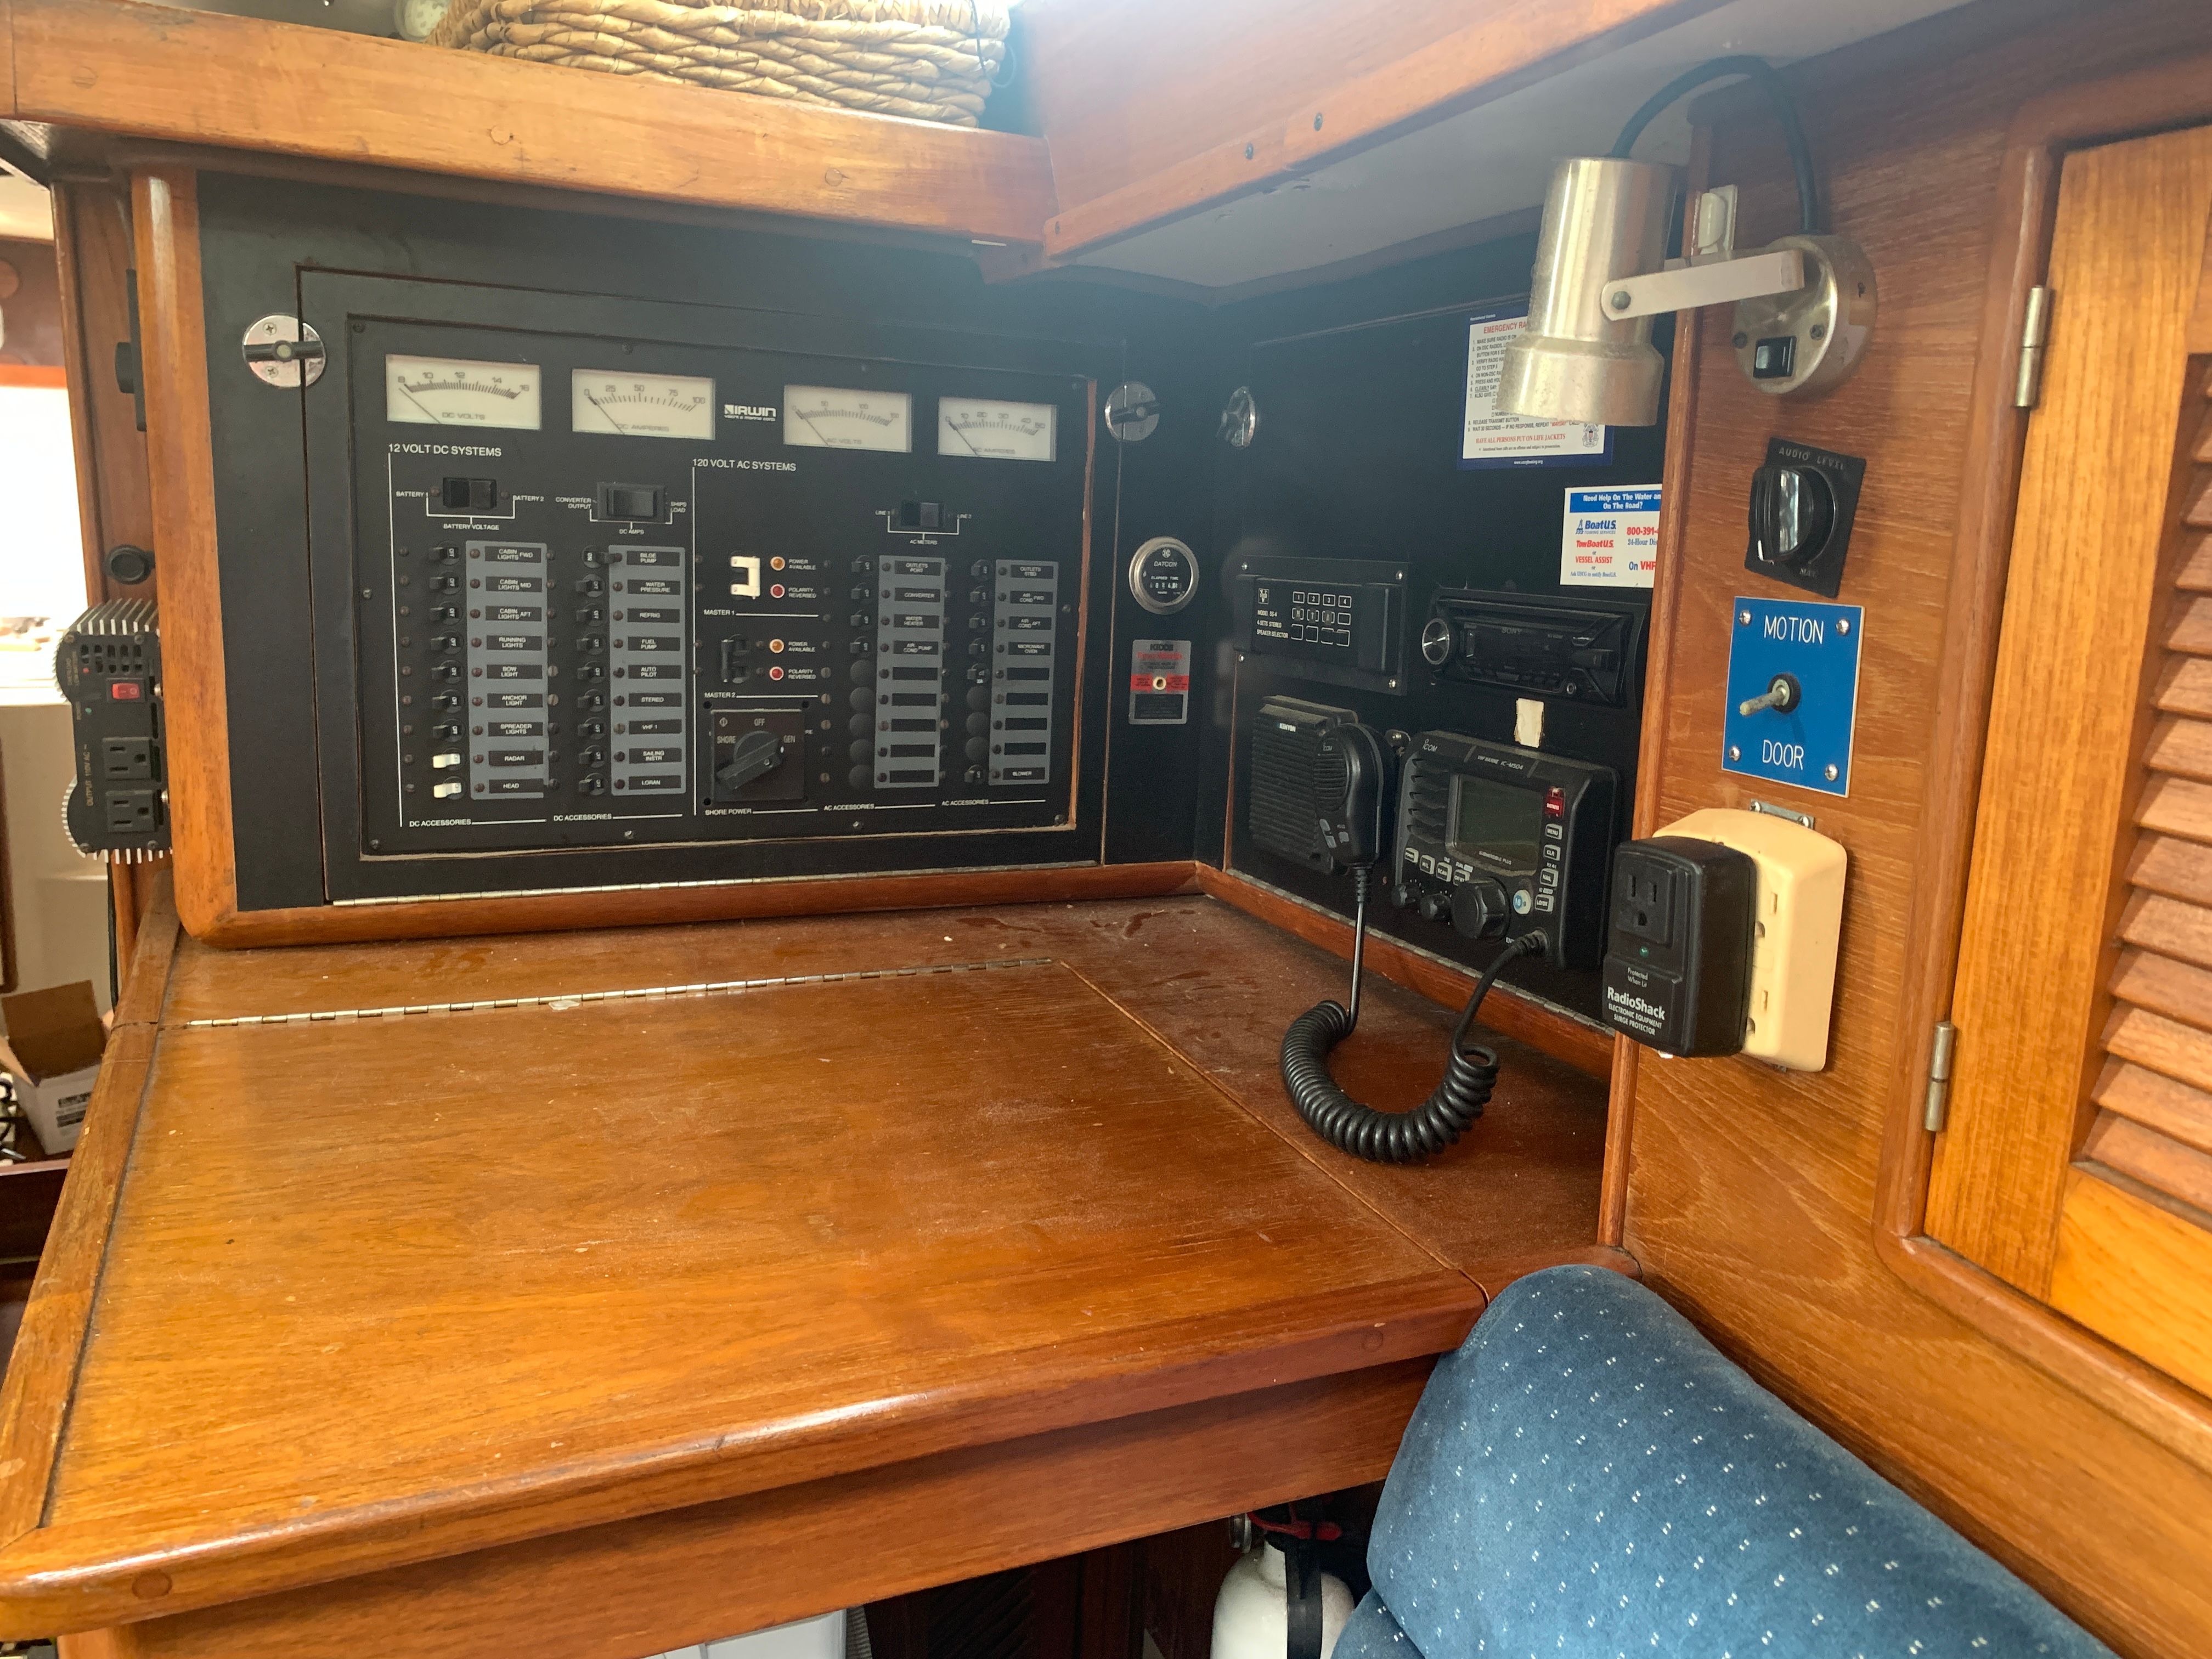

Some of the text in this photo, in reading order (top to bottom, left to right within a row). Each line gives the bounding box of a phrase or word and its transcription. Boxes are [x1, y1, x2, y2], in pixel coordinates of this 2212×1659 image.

[1483, 322, 1517, 334] EMERGENCY
[605, 385, 616, 393] 25
[692, 396, 706, 404] 100
[389, 443, 501, 456] 12 VOLT DC SYSTEMS
[1779, 447, 1844, 470] AUDIO LEVEL
[693, 459, 796, 472] 120 VOLT AC SYSTEMS
[1629, 561, 1656, 571] On VHF
[1764, 615, 1824, 645] MOTION
[717, 735, 736, 744] SHORE
[1762, 740, 1804, 770] DOOR
[1547, 828, 1559, 836] MENU
[1437, 868, 1447, 877] SCAN
[1515, 898, 1521, 906] 16
[1627, 967, 1648, 980] Protected
[1627, 975, 1640, 985] When
[1607, 986, 1665, 1020] RadioShack
[1608, 1003, 1662, 1029] ELECTRONIC EQUIPMENT
[1613, 1014, 1655, 1036] SURGE PROTECTOR
